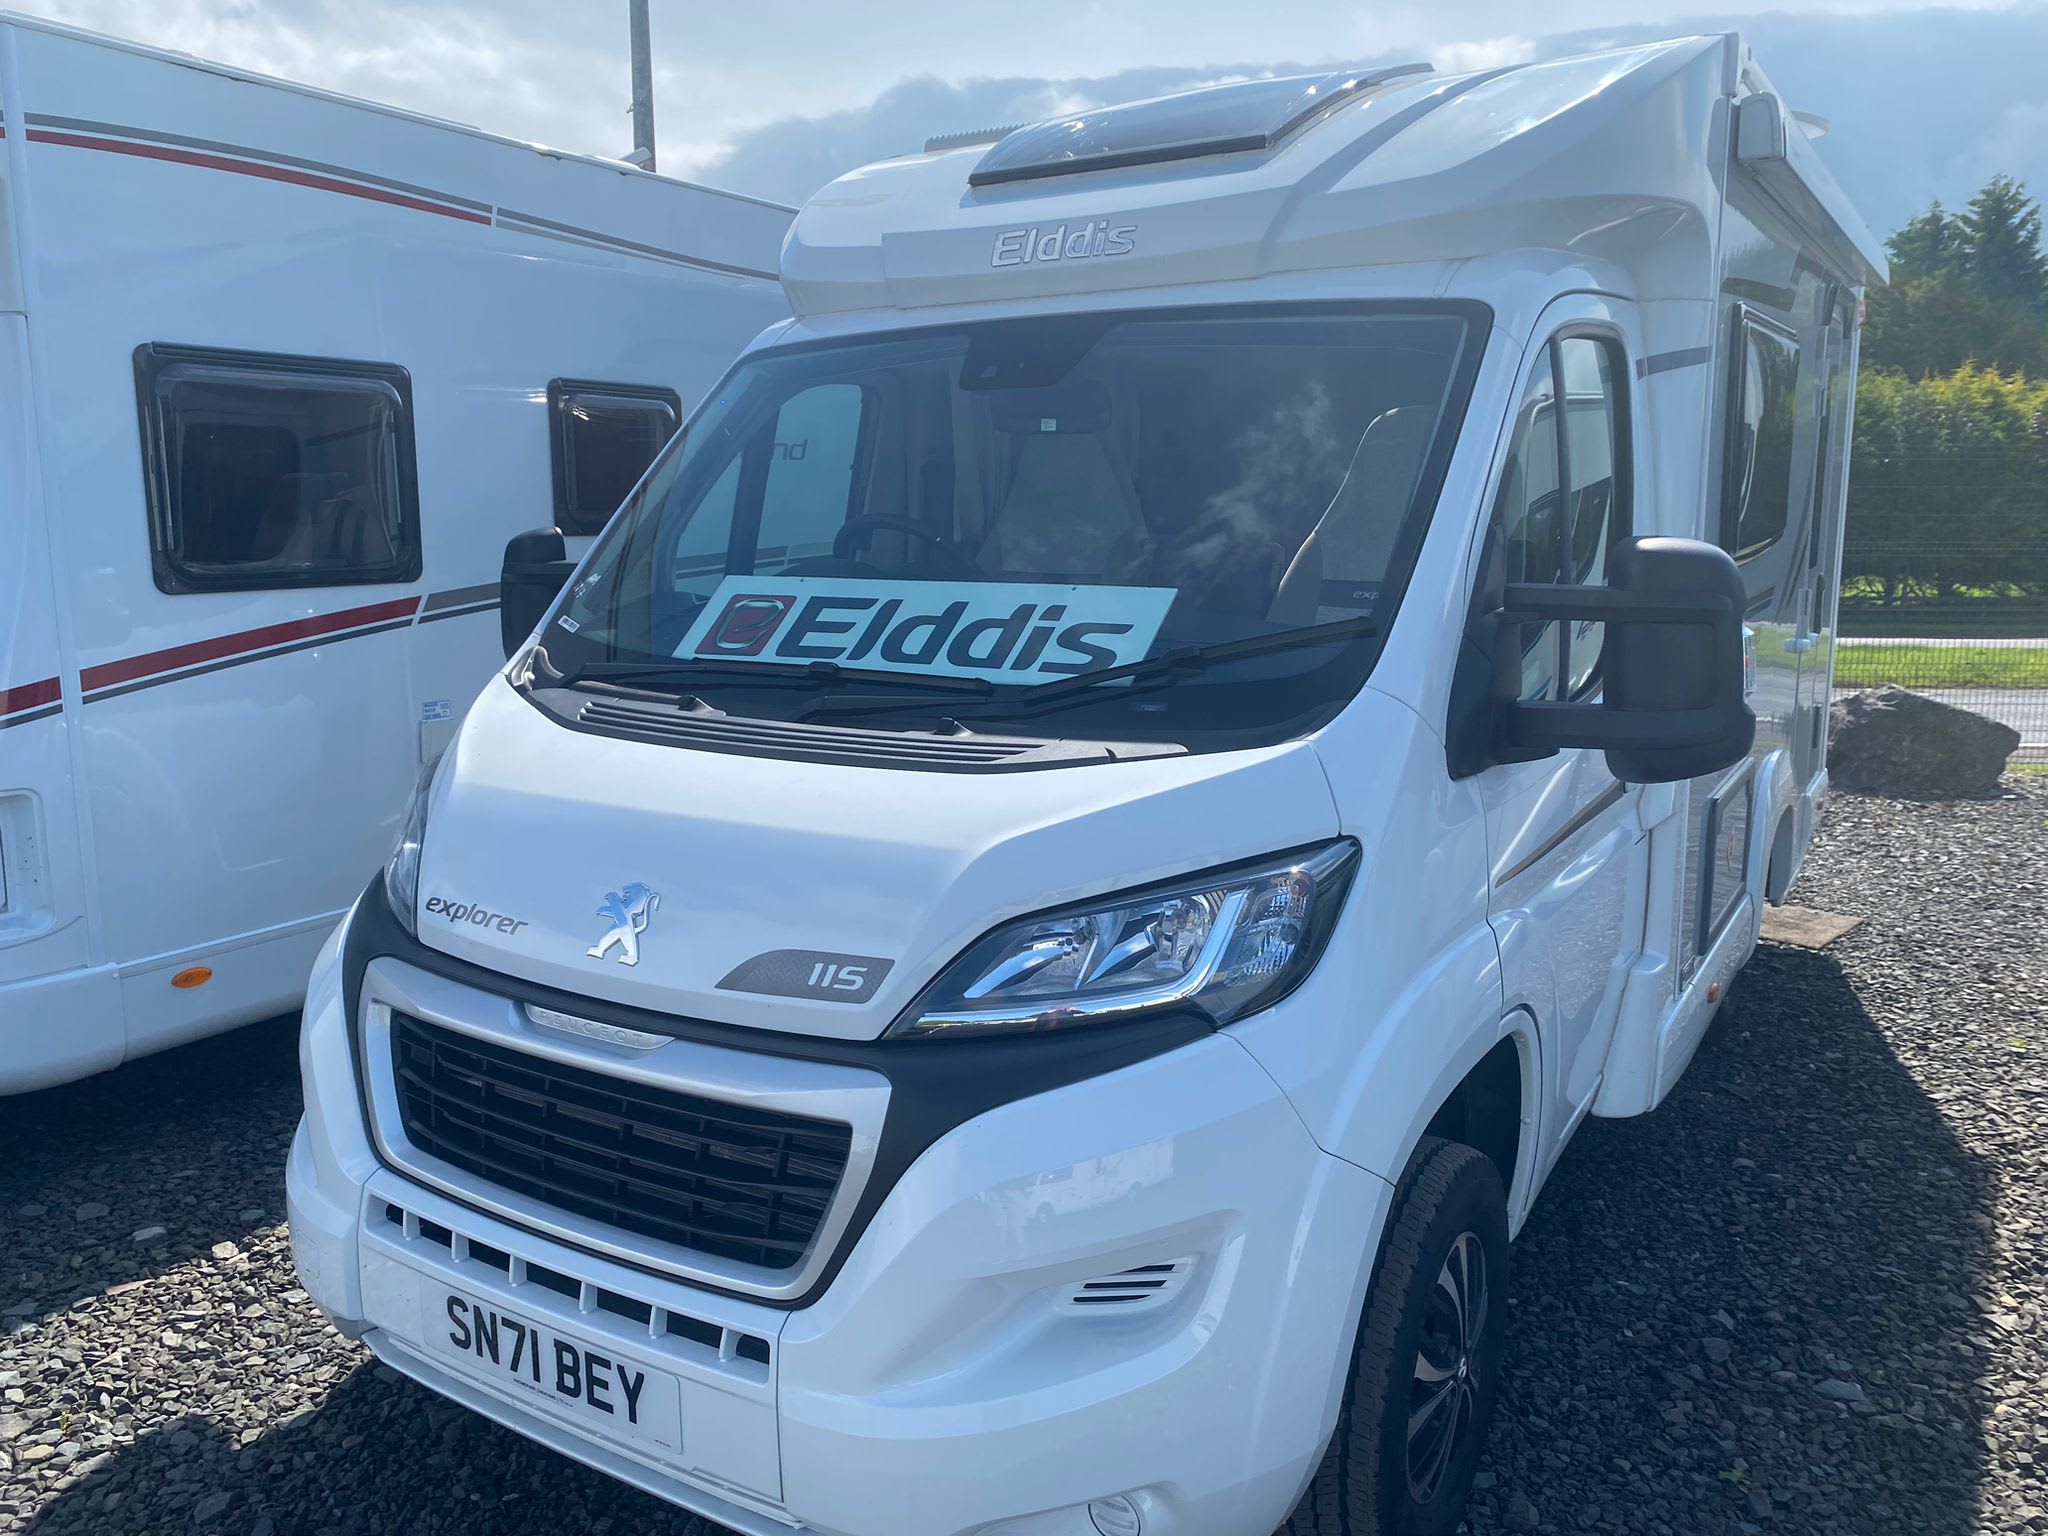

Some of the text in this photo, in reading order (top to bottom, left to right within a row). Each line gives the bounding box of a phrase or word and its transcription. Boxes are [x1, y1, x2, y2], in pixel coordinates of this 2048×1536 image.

[991, 220, 1138, 267] Elddis
[775, 596, 1135, 672] Elddis
[425, 896, 529, 935] explorer
[539, 1010, 643, 1045] PEUGEOT
[447, 1295, 645, 1424] SN71 BEY
